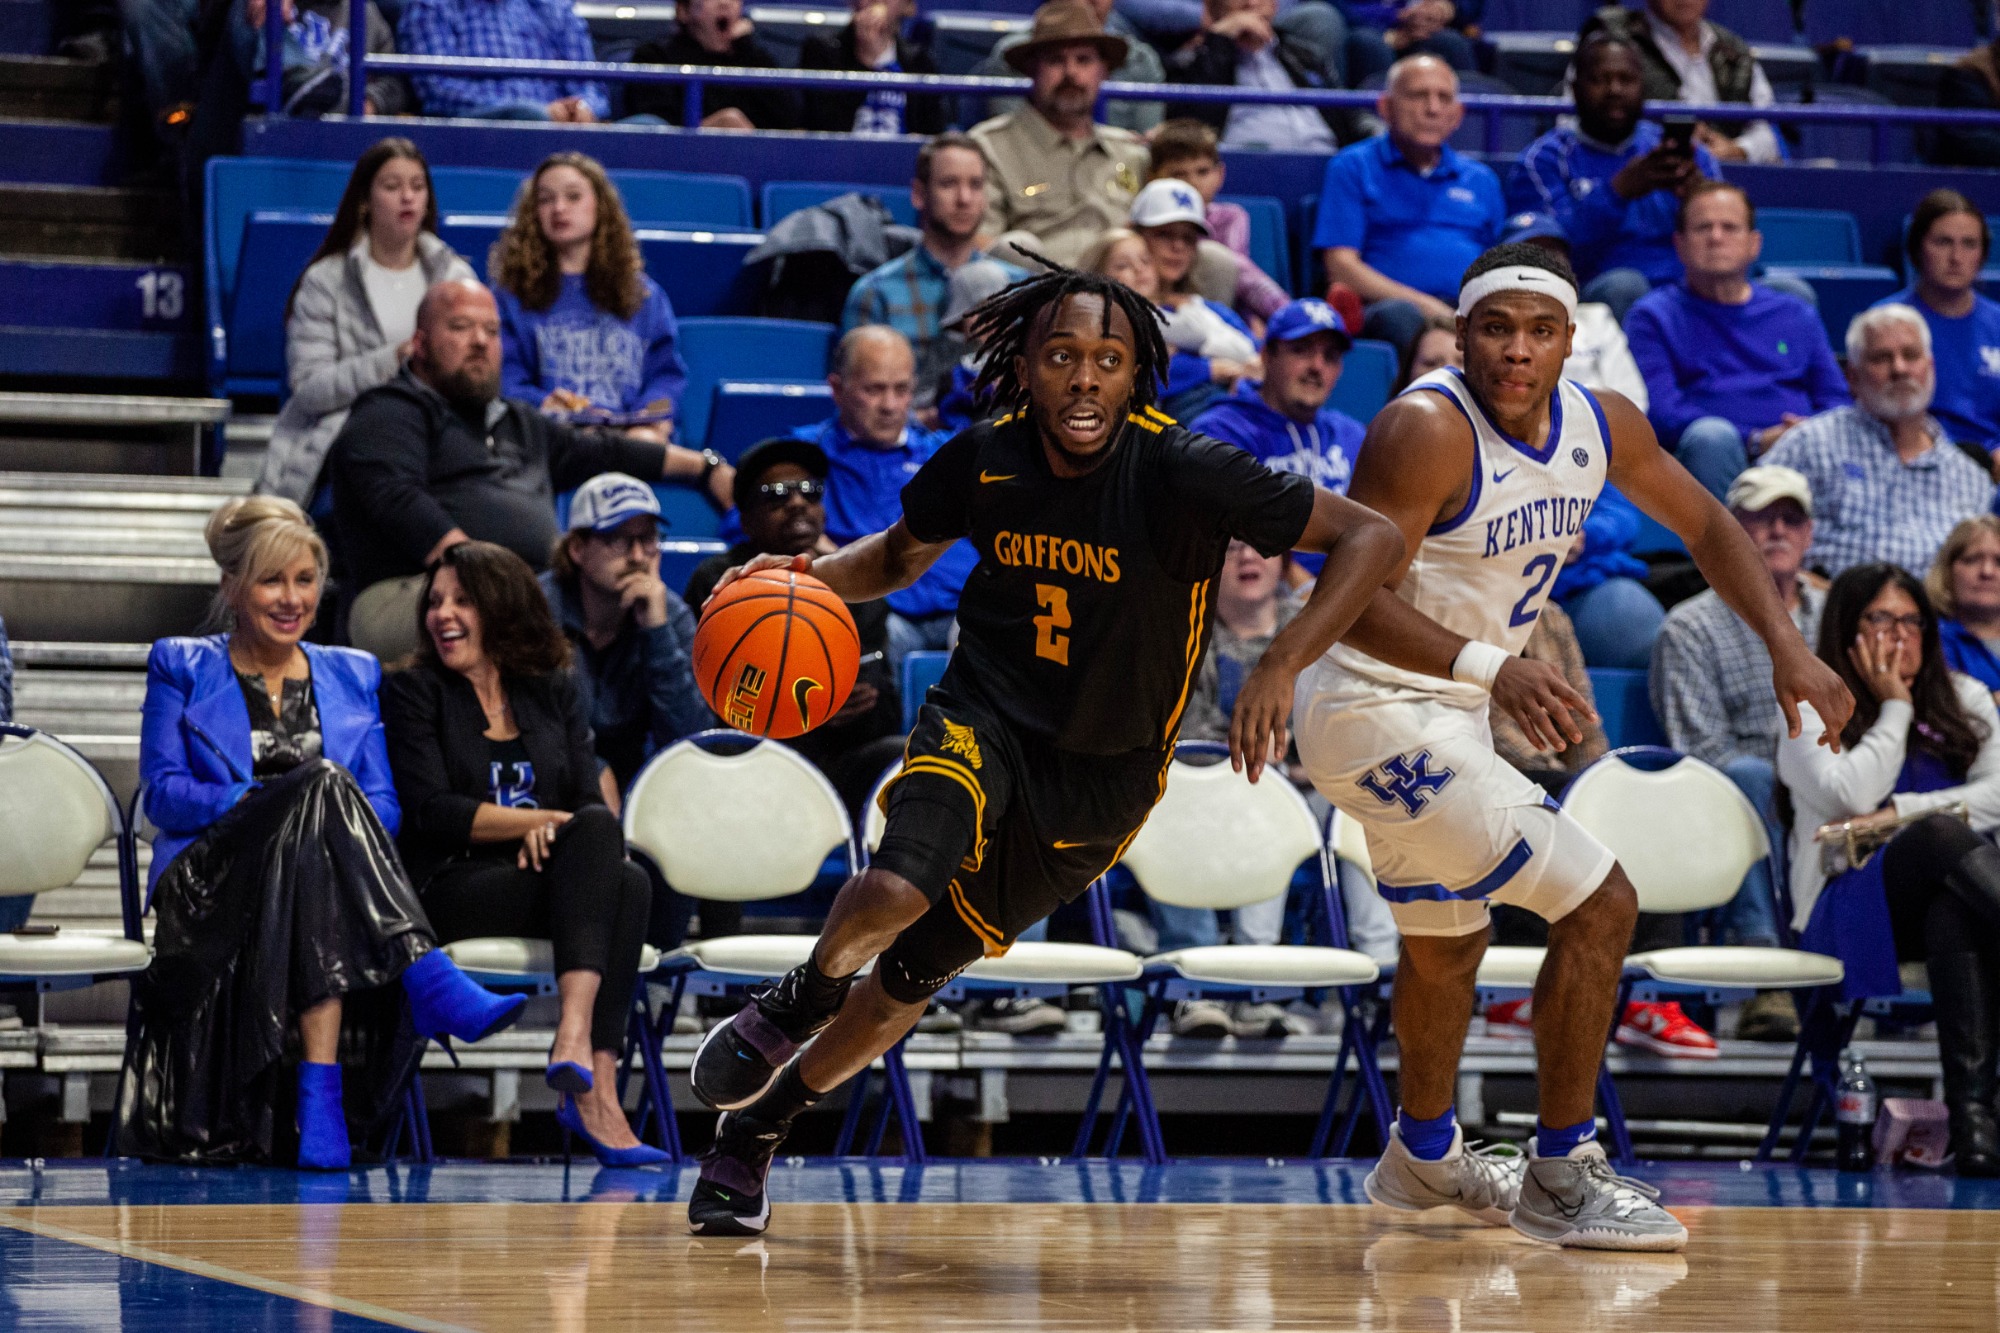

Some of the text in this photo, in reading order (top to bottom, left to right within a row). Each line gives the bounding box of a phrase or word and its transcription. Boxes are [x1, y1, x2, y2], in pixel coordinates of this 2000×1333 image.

[135, 271, 184, 319] 13
[994, 530, 1121, 583] GRIFFONS
[1509, 554, 1558, 628] 2
[1033, 583, 1072, 666] 2
[729, 662, 768, 733] ELITE
[1355, 748, 1456, 820] UK
